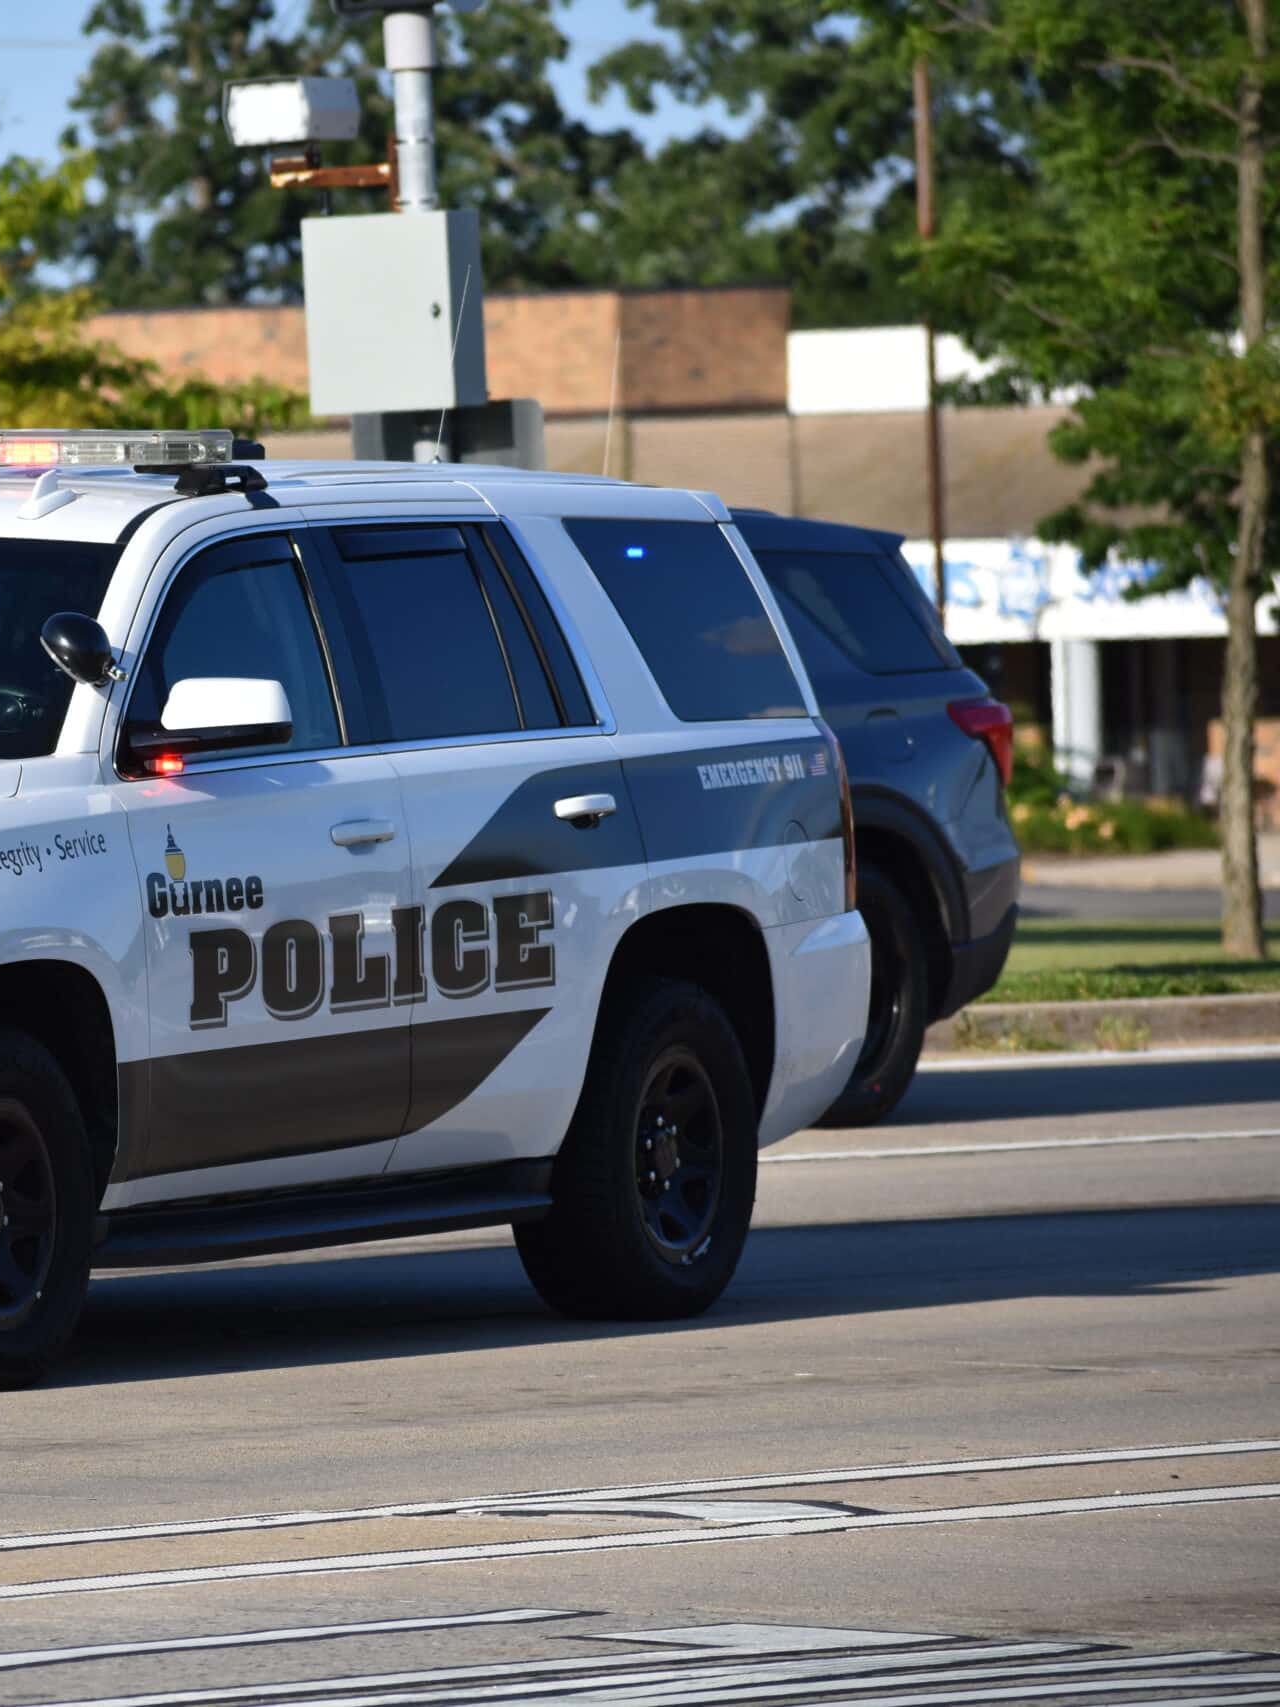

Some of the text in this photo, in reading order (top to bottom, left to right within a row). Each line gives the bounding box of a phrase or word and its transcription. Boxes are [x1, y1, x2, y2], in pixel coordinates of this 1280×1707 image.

[696, 754, 806, 790] EMERGENCY 911
[54, 830, 107, 861] Service
[146, 872, 264, 918] Gurnee
[188, 889, 556, 1031] POLICE
